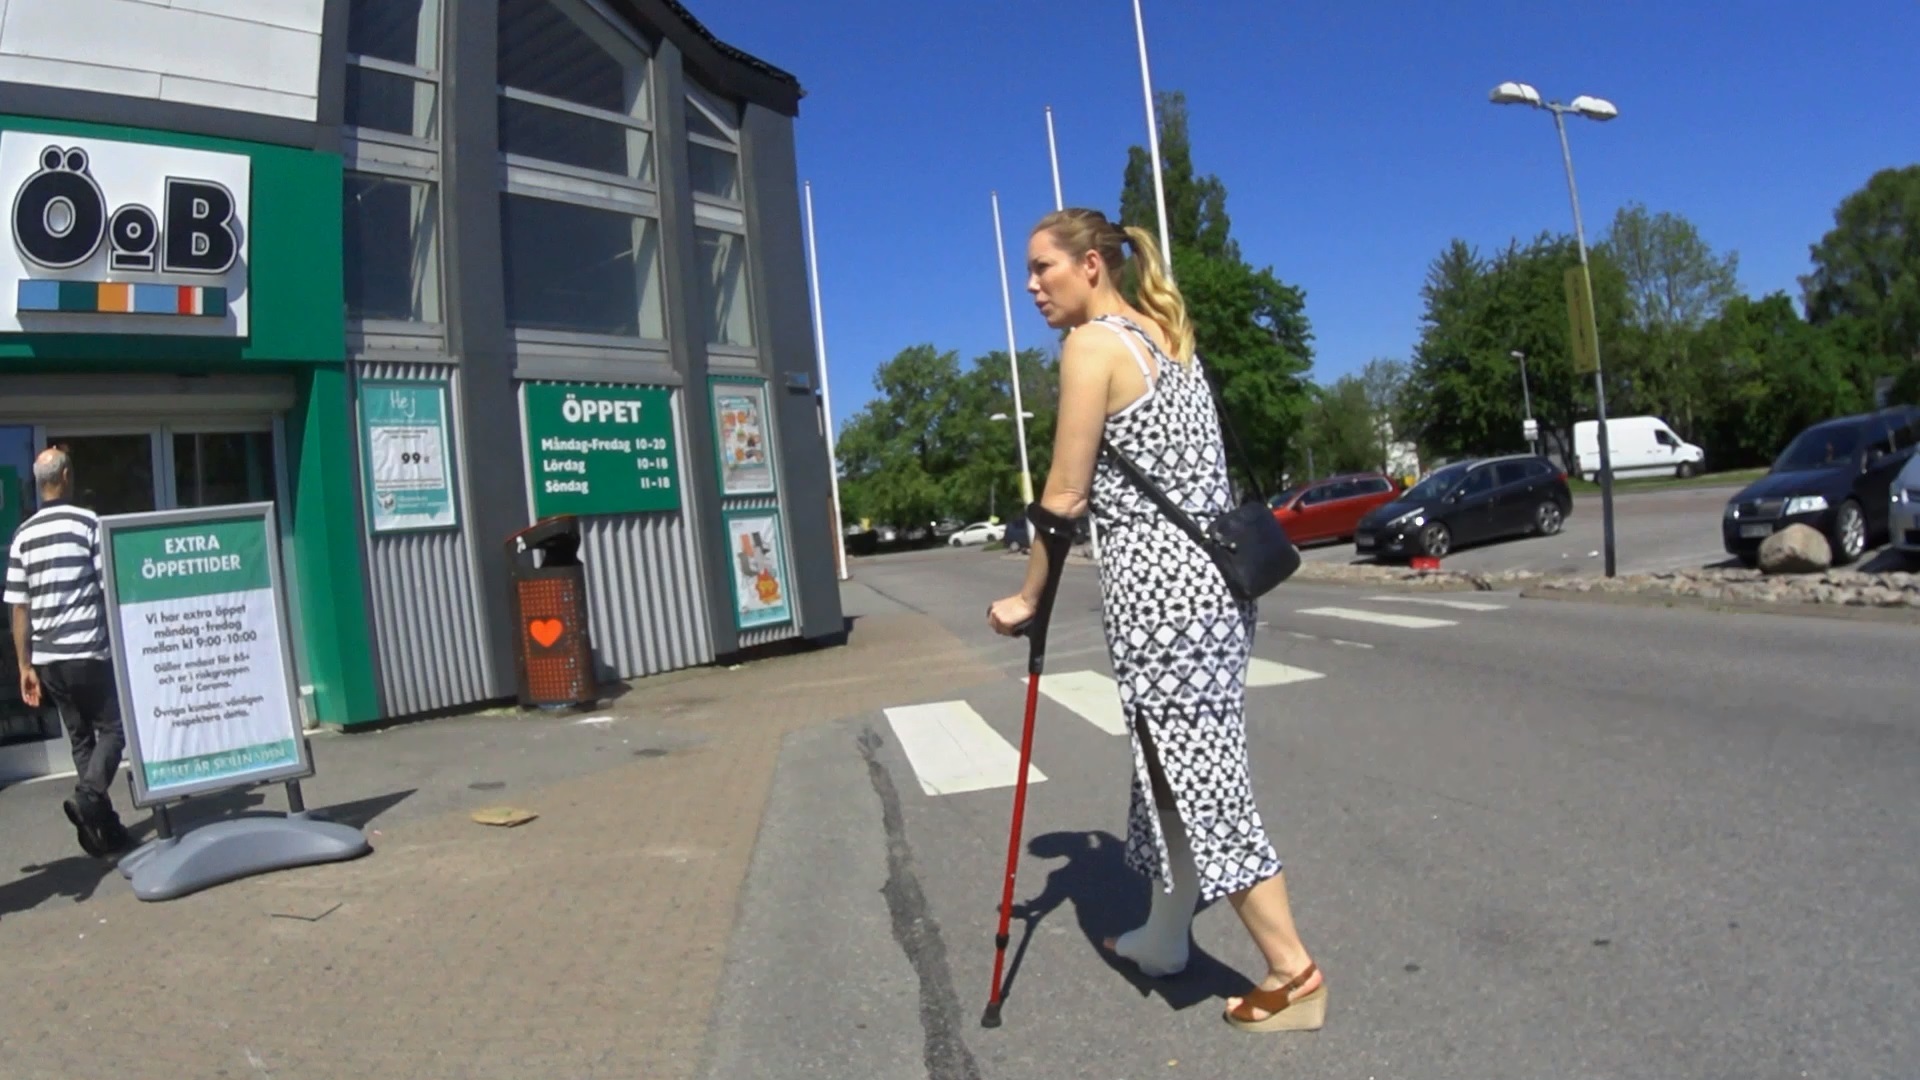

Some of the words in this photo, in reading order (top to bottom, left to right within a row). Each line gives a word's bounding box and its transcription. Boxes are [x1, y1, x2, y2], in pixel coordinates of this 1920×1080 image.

[11, 144, 239, 275] ÖoB
[390, 389, 416, 418] Hej
[562, 393, 642, 423] ÖPPET
[635, 438, 666, 450] 10-20
[543, 458, 586, 474] Lördag
[637, 457, 668, 469] 10-18
[545, 479, 589, 495] Söndag
[640, 476, 671, 489] 11-18
[164, 534, 220, 555] EXTRA
[141, 554, 241, 579] ÖPPETTIDER
[145, 613, 158, 624] Vi
[160, 612, 180, 622] har
[183, 609, 212, 620] extra
[215, 604, 246, 619] öppet
[142, 641, 179, 655] mellan
[182, 638, 193, 650] kl
[153, 661, 181, 673] Gäller
[217, 655, 230, 663] för
[158, 675, 175, 685] och
[180, 685, 193, 694] för
